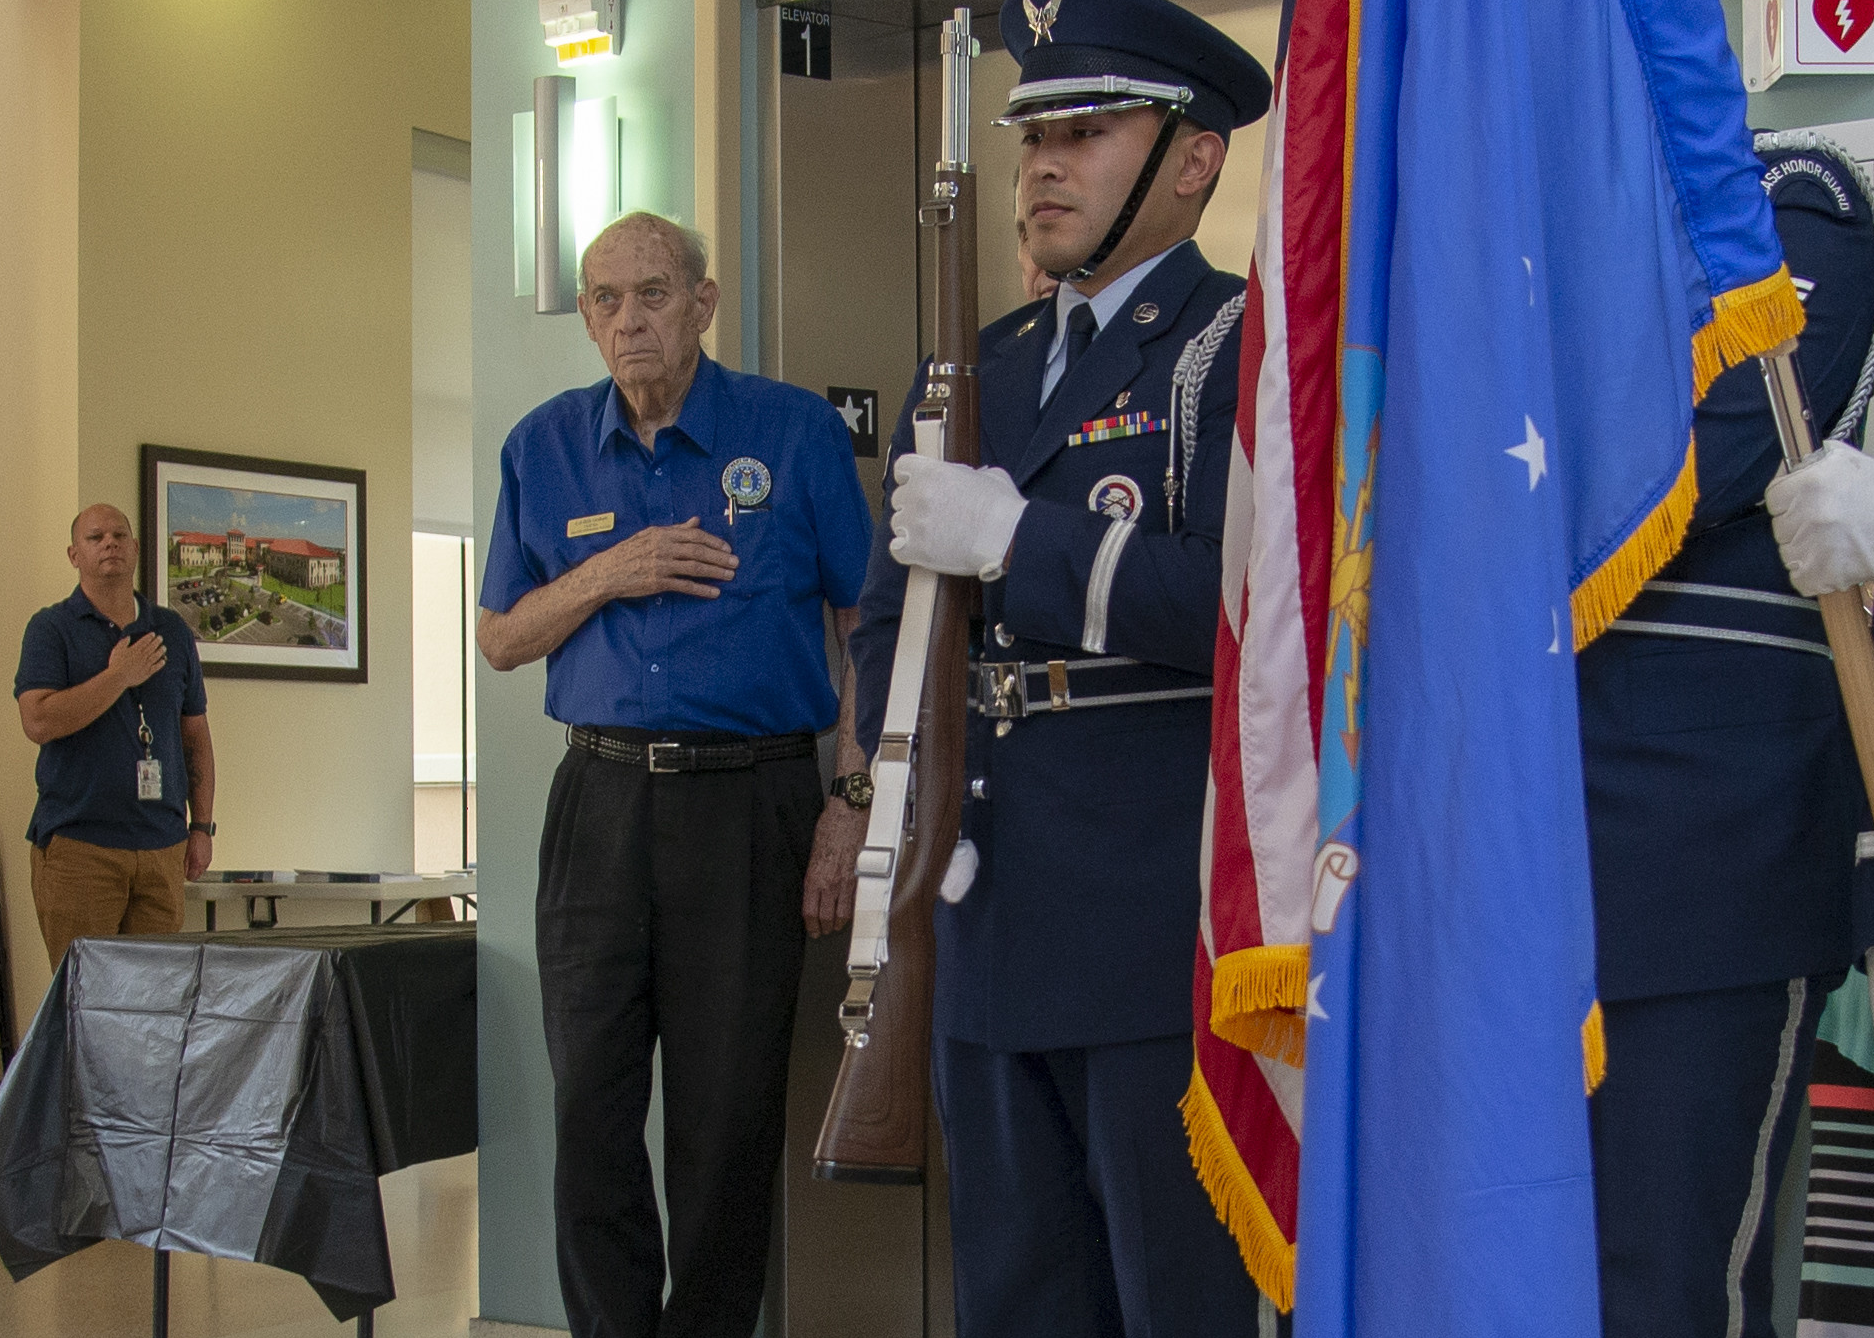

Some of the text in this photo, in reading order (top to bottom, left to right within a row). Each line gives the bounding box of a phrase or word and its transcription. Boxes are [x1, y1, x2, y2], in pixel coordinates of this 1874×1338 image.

[781, 7, 831, 27] ELEVATOR
[800, 23, 811, 77] 1
[1760, 158, 1850, 211] ASE HONOR GUARD
[862, 397, 874, 436] 1
